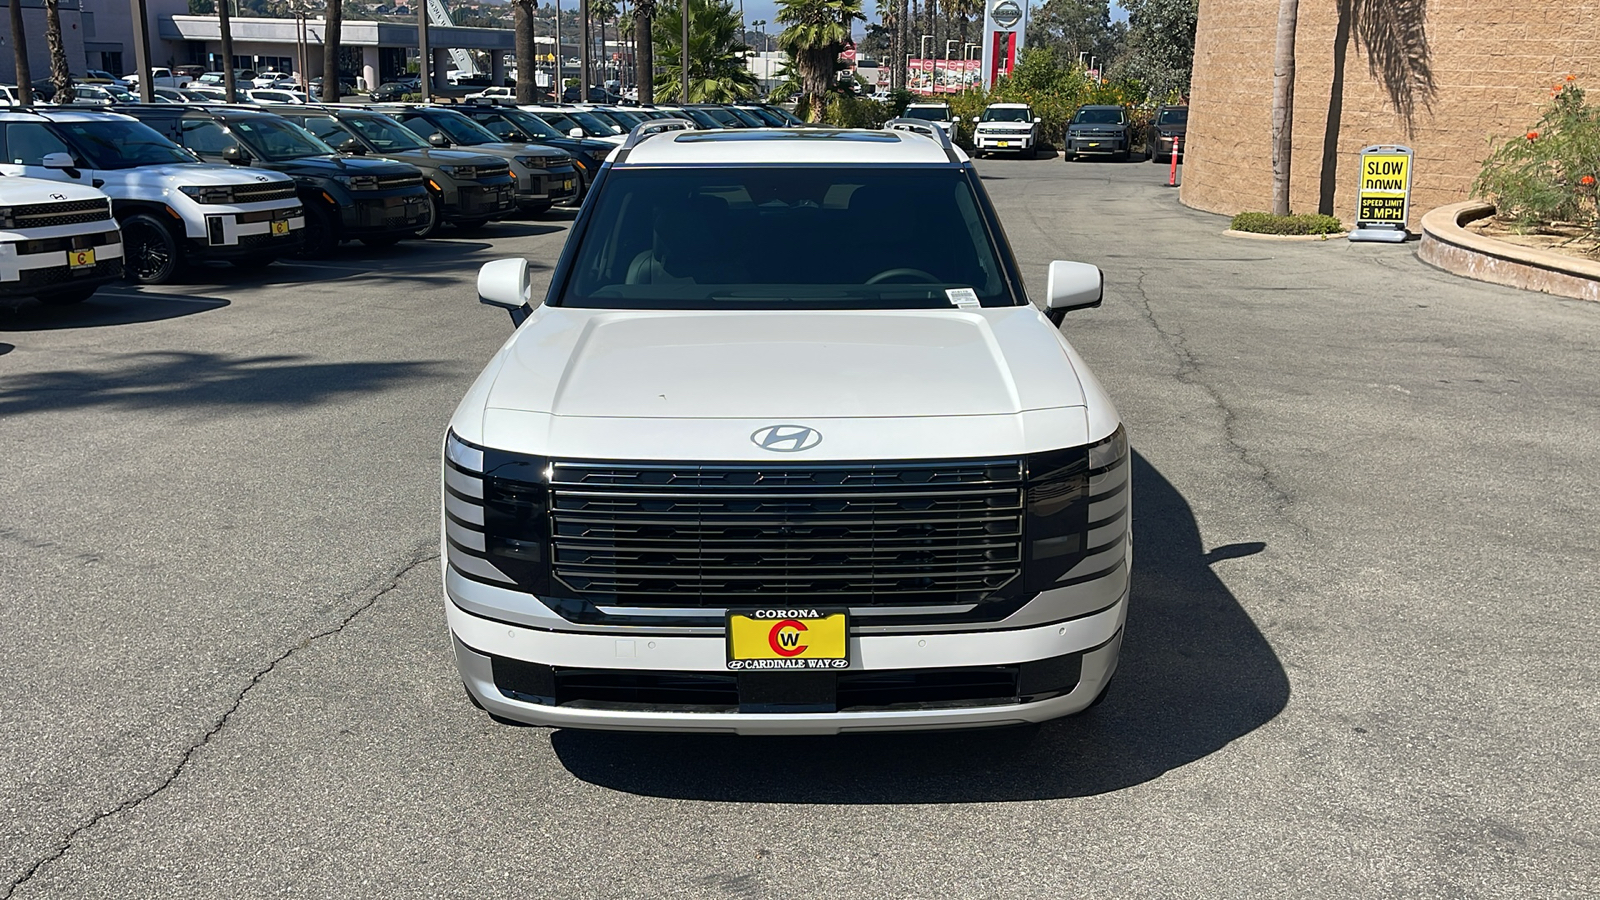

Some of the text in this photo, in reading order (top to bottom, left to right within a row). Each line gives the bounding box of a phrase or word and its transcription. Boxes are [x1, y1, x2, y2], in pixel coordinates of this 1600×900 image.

[1367, 161, 1403, 175] SLOW
[1366, 179, 1402, 190] DOWN
[1362, 199, 1403, 207] SPEED LIMIT
[1362, 208, 1402, 219] 5 MPH
[755, 609, 819, 618] CORONA
[780, 632, 800, 647] W
[745, 659, 832, 669] CARDINALE WAY
